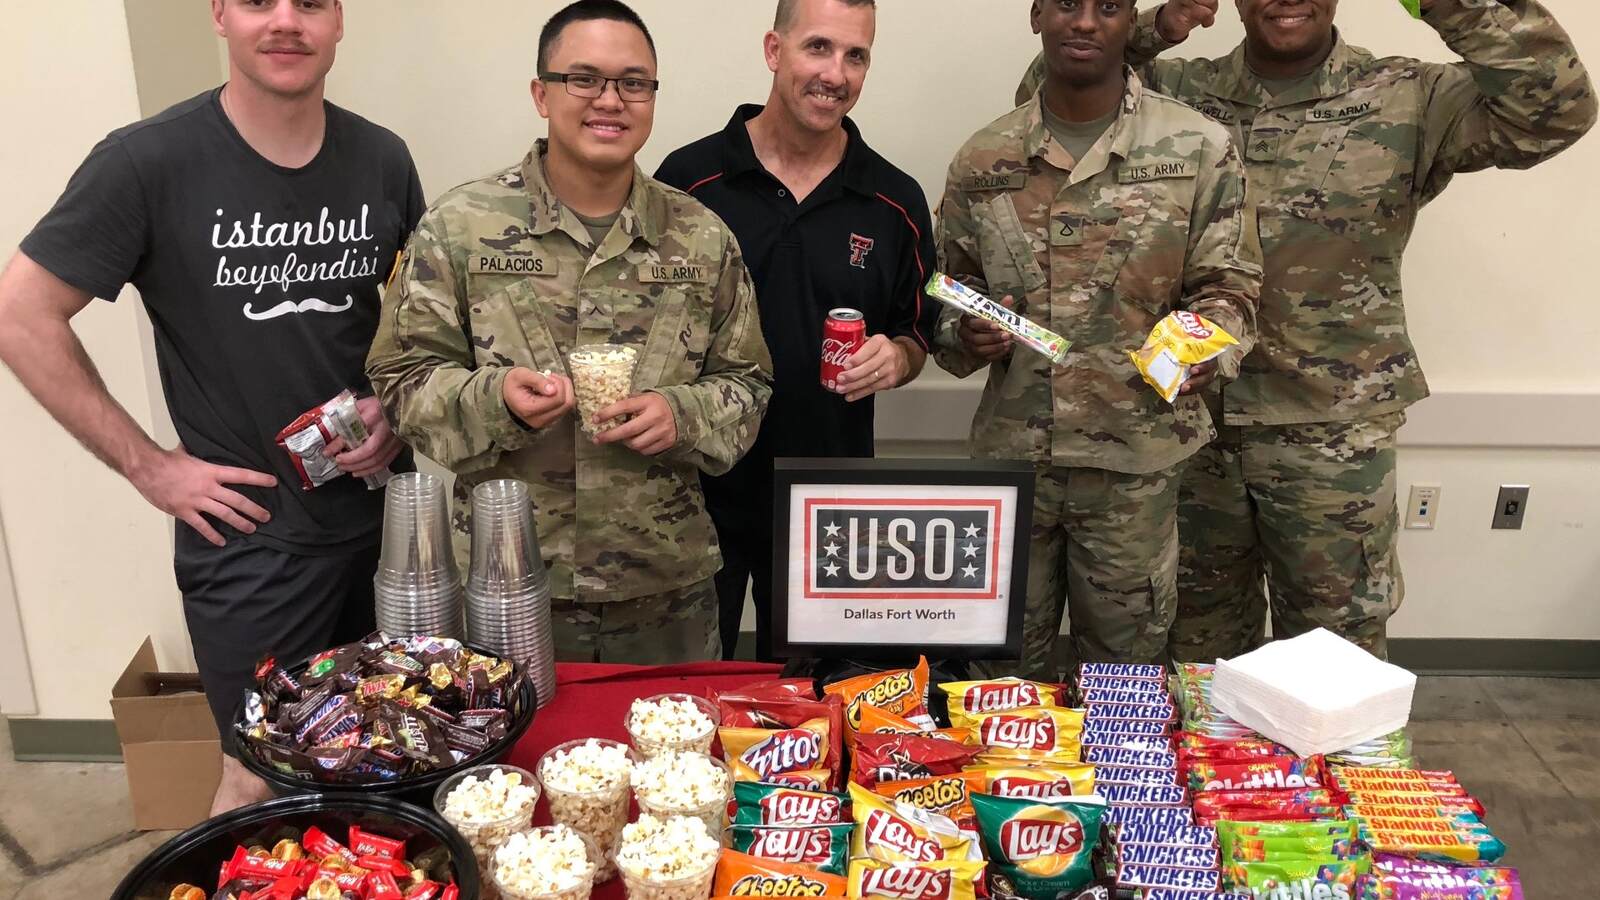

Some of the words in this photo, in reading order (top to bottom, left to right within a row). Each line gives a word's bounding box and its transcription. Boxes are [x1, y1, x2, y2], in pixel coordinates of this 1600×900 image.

[1313, 109, 1335, 119] U.S.
[1338, 102, 1372, 117] ARMY
[1130, 167, 1151, 180] U.S.
[1154, 163, 1186, 177] ARMY
[974, 176, 1009, 187] ROLLINS
[211, 204, 374, 249] istanbul
[213, 246, 380, 294] beyefendisi
[480, 256, 543, 272] PALACIOS
[651, 266, 670, 280] U.S.
[672, 266, 702, 280] ARMY
[848, 517, 956, 581] USO
[844, 608, 883, 620] Dallas
[886, 608, 912, 620] Fort
[915, 608, 956, 620] Worth
[1082, 663, 1162, 677] SNICKERS
[1082, 676, 1161, 691] SNICKERS
[1087, 689, 1169, 704] SNICKERS
[1089, 704, 1173, 719] SNICKERS
[1083, 718, 1164, 734] SNICKERS
[1087, 747, 1175, 768] SNICKERS
[1343, 767, 1420, 780] Starburst
[1096, 783, 1184, 803] SNICKERS
[1350, 780, 1430, 792] Starburst
[1360, 793, 1440, 806] Starburst
[1101, 806, 1191, 825] SNICKERS
[1357, 806, 1438, 819] Starburst
[1370, 818, 1451, 832] Starburst
[1119, 823, 1216, 845] SNICKERS
[1377, 832, 1460, 846] Starburst
[1122, 844, 1217, 868] SNICKERS
[1121, 865, 1218, 889] SNICKERS
